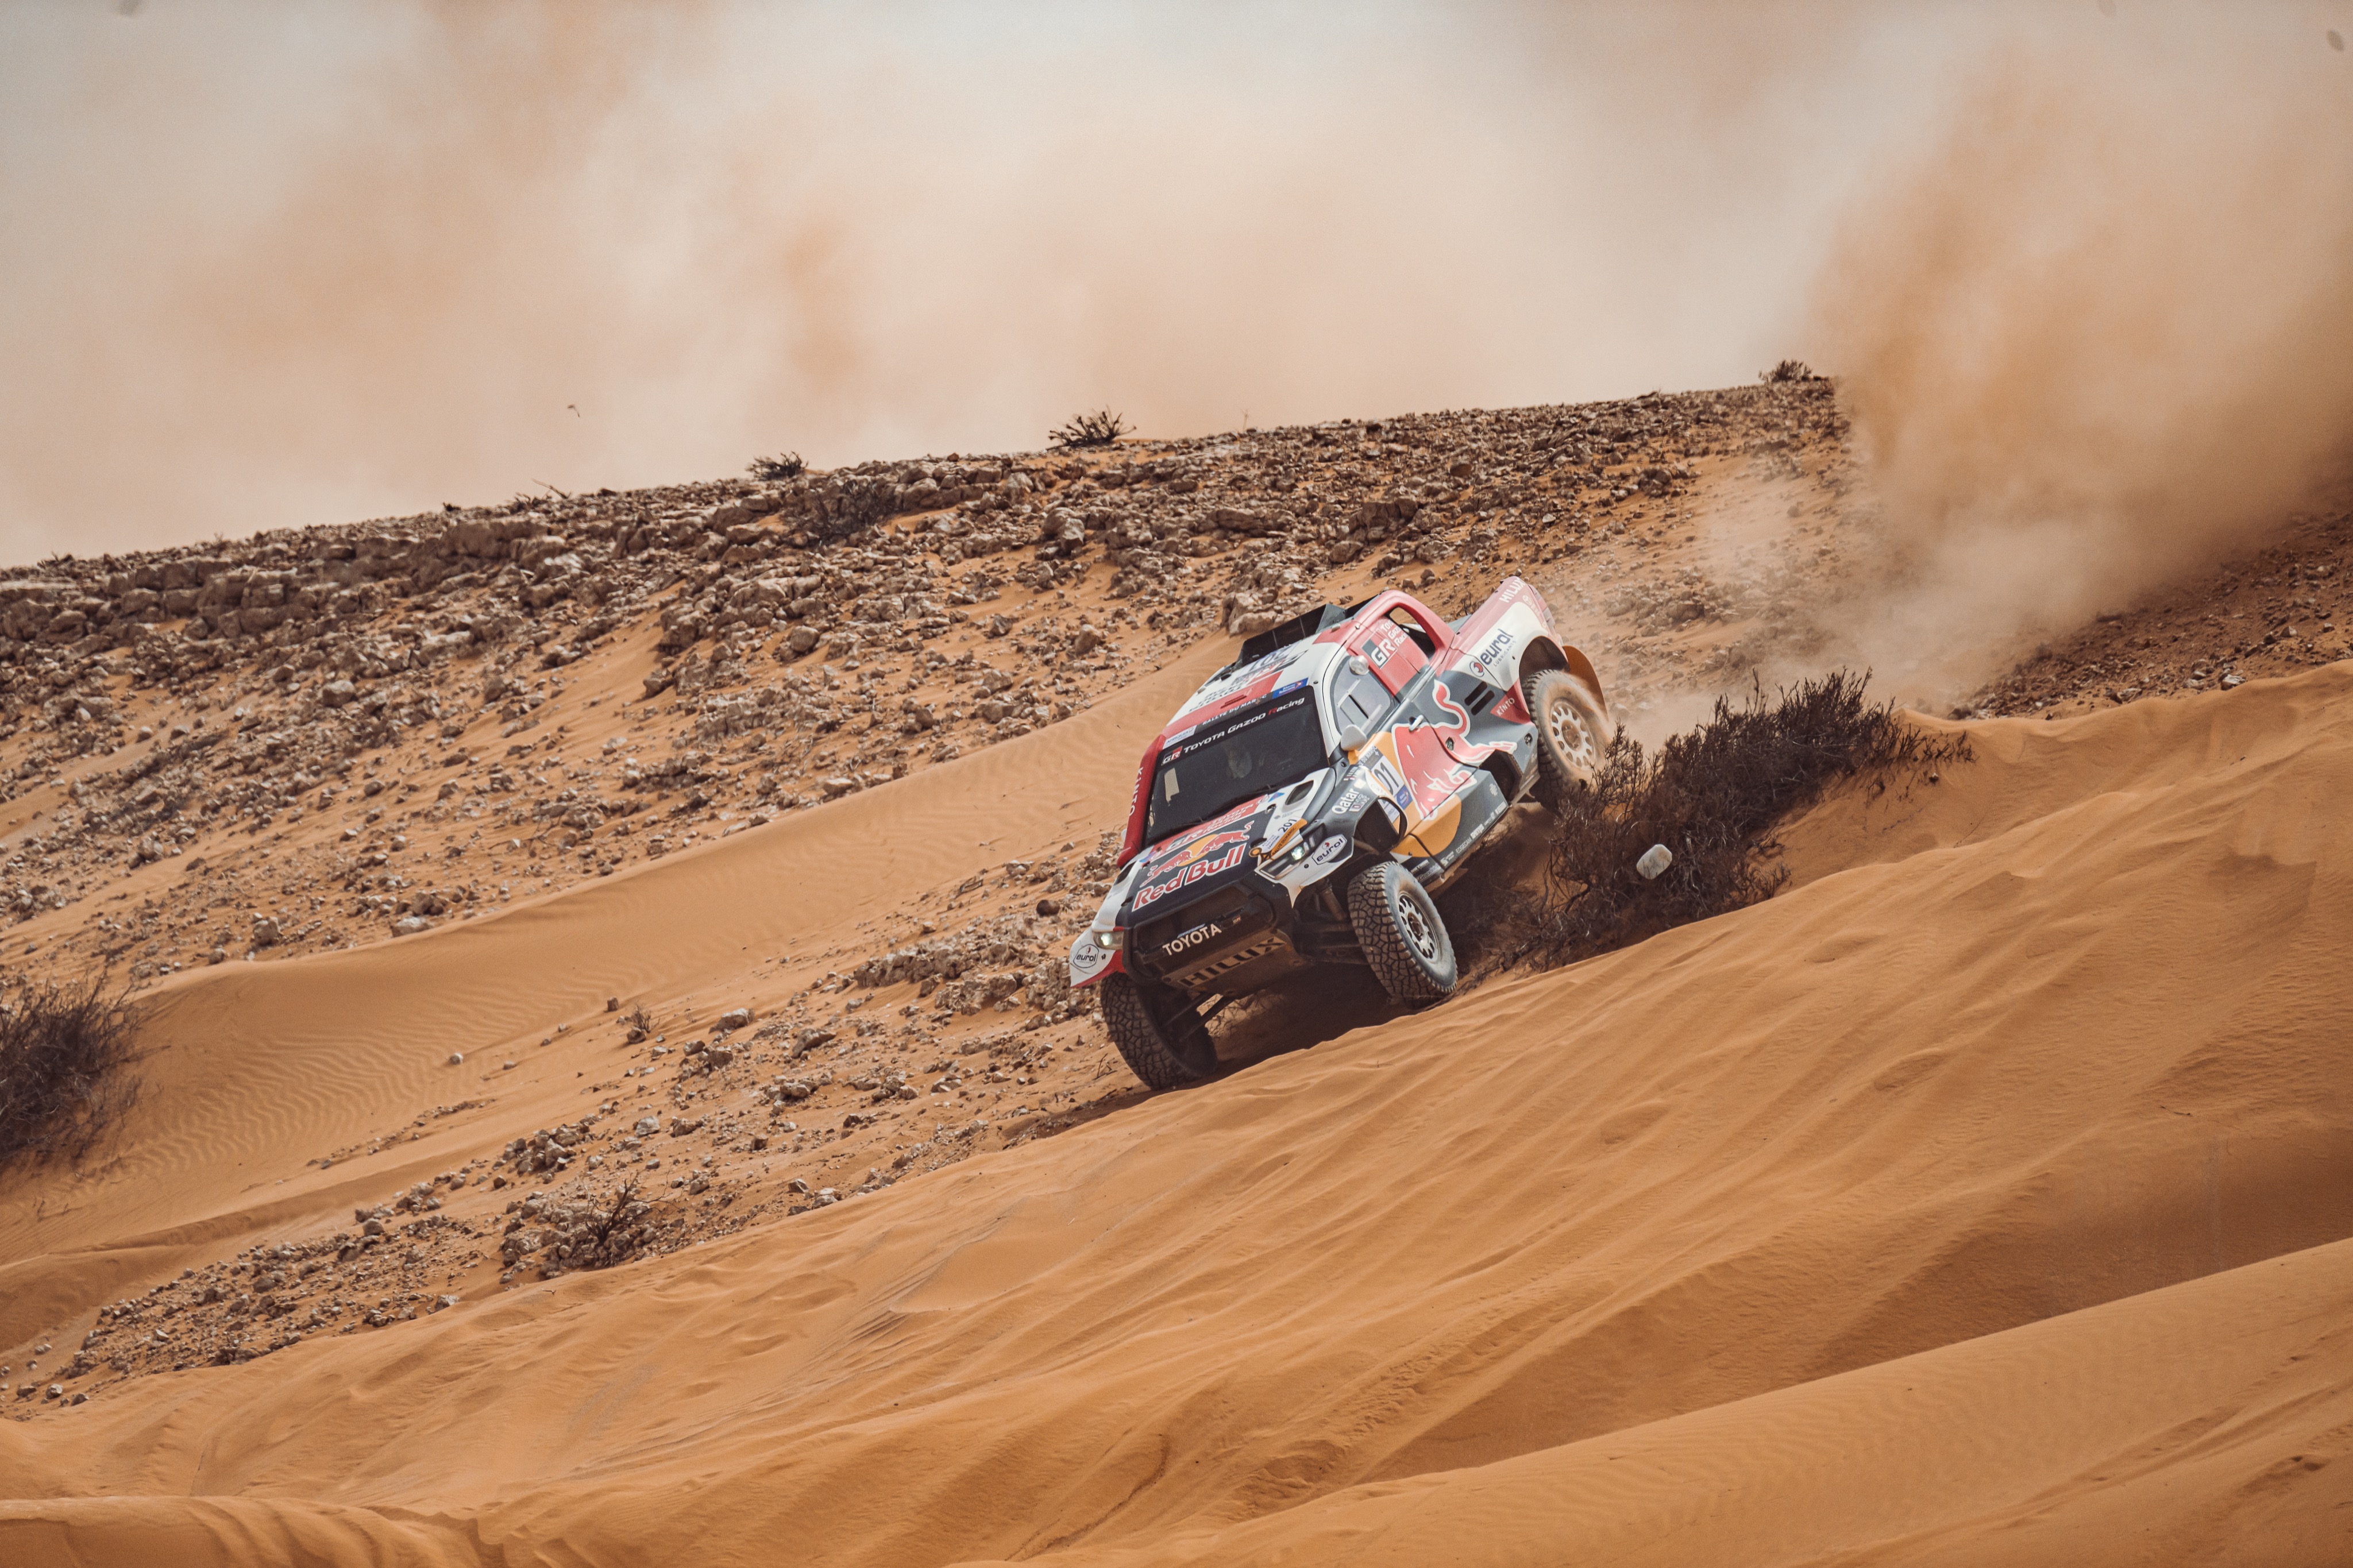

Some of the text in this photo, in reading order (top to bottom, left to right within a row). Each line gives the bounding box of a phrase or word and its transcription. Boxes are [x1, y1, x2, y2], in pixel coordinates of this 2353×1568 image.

[1499, 578, 1525, 603] HILUX
[1371, 638, 1396, 666] GR
[1480, 628, 1513, 666] eurol
[1494, 640, 1517, 667] LUBRICANTS
[1202, 711, 1227, 725] RALLYE
[1229, 705, 1239, 714] DU
[1163, 697, 1305, 764] GR TOYOTA GAZOO Racing
[1374, 762, 1399, 795] 01
[1332, 788, 1359, 814] Qatar
[1278, 819, 1298, 832] 201
[1317, 839, 1343, 862] eurol
[1456, 837, 1471, 853] EDGECAM
[1132, 843, 1247, 912] Red Bull
[1162, 923, 1222, 956] TOYOTA
[1076, 953, 1096, 962] eurol
[1179, 937, 1287, 986] HILUX
